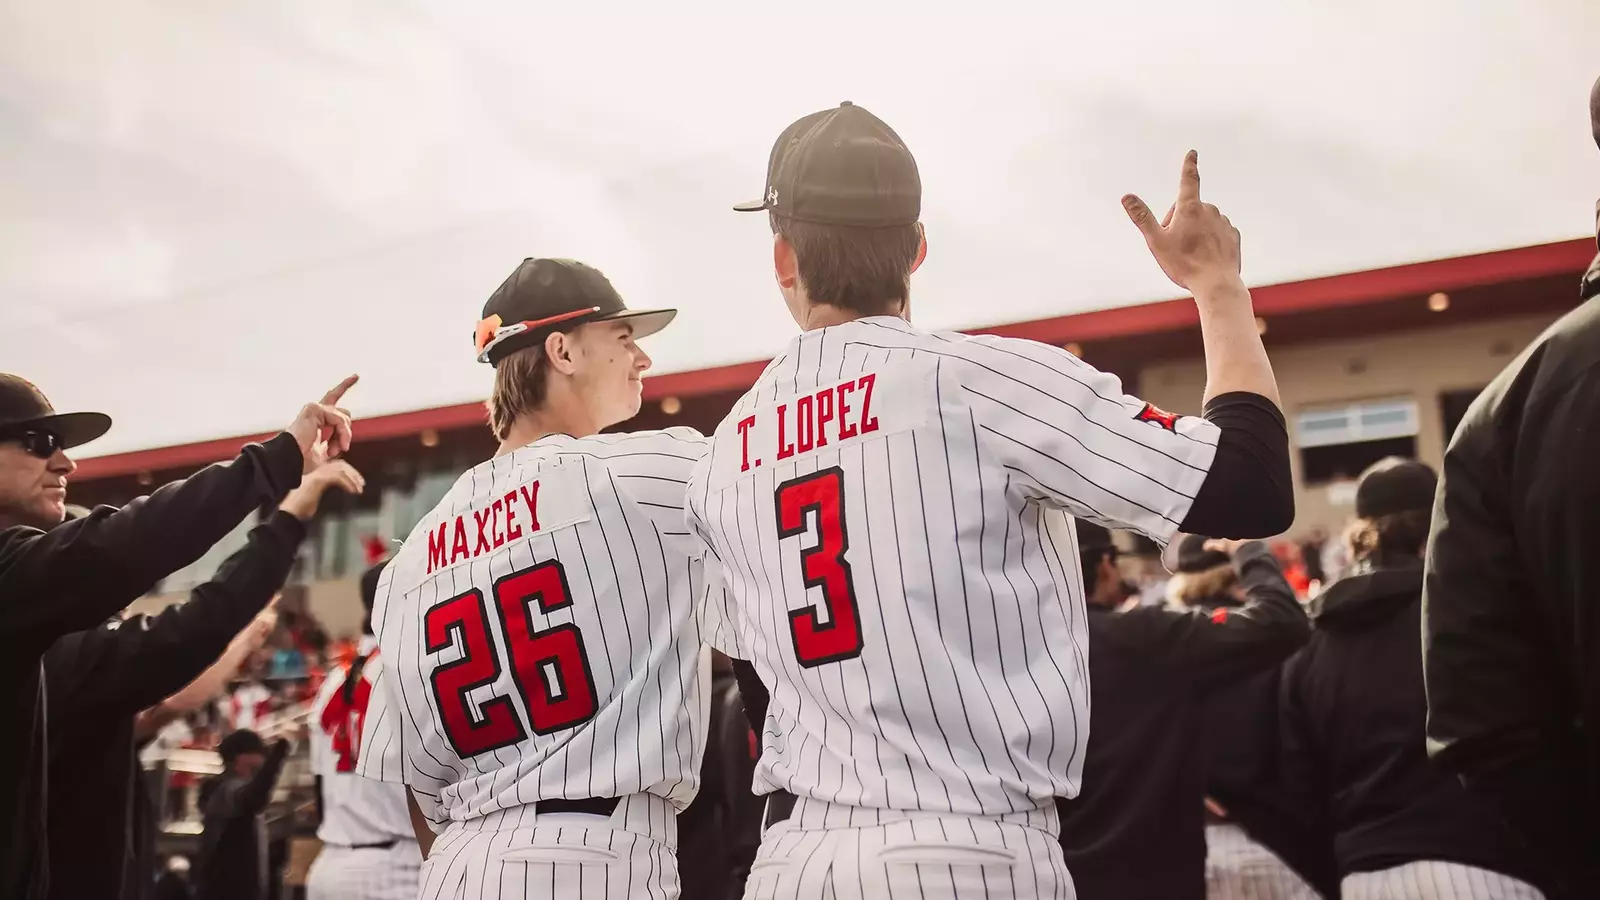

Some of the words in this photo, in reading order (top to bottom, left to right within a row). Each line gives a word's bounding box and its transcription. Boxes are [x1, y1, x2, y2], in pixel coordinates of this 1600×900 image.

[737, 415, 762, 473] T.
[776, 373, 879, 461] LOPEZ
[426, 480, 542, 575] MAXCEY
[774, 465, 864, 669] 3
[424, 558, 599, 760] 26
